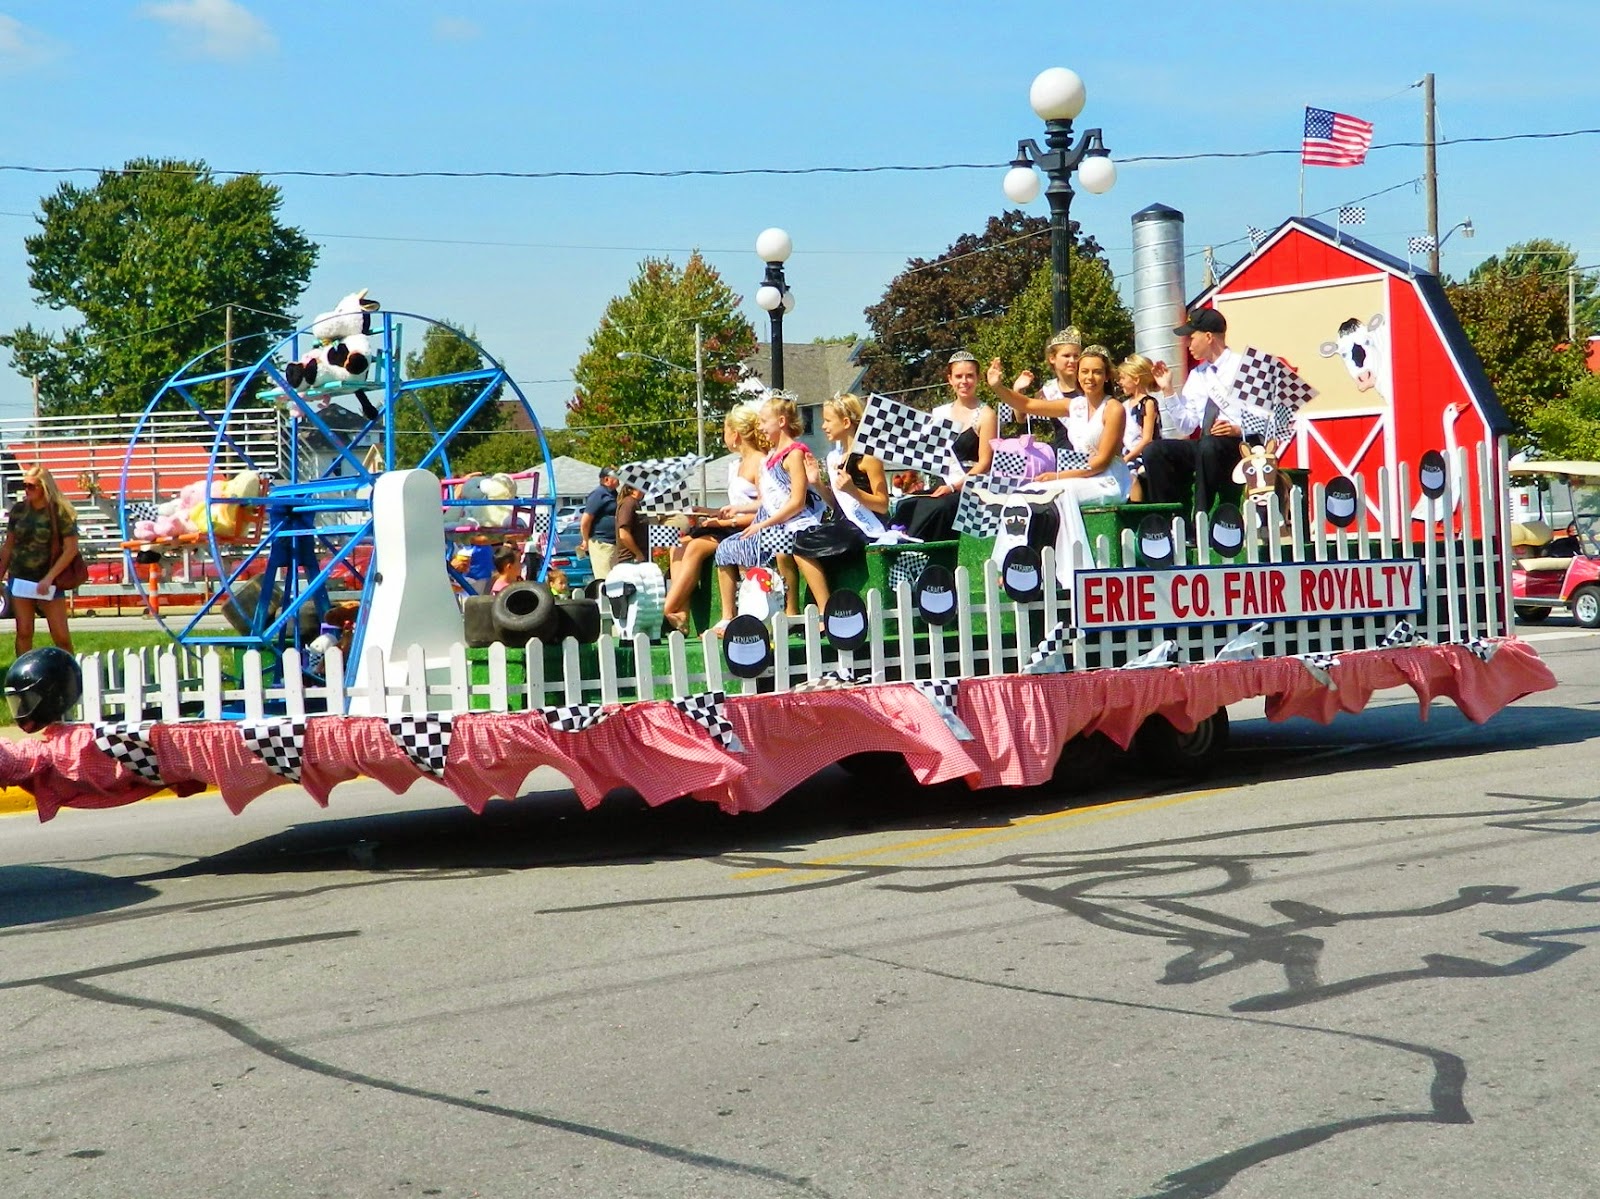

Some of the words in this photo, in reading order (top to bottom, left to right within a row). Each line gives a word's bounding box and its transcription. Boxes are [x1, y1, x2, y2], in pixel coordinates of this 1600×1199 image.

[1084, 575, 1156, 623] ERIE
[1171, 572, 1216, 618] CO.
[1224, 570, 1286, 616] FAIR
[1301, 565, 1414, 612] ROYALTY
